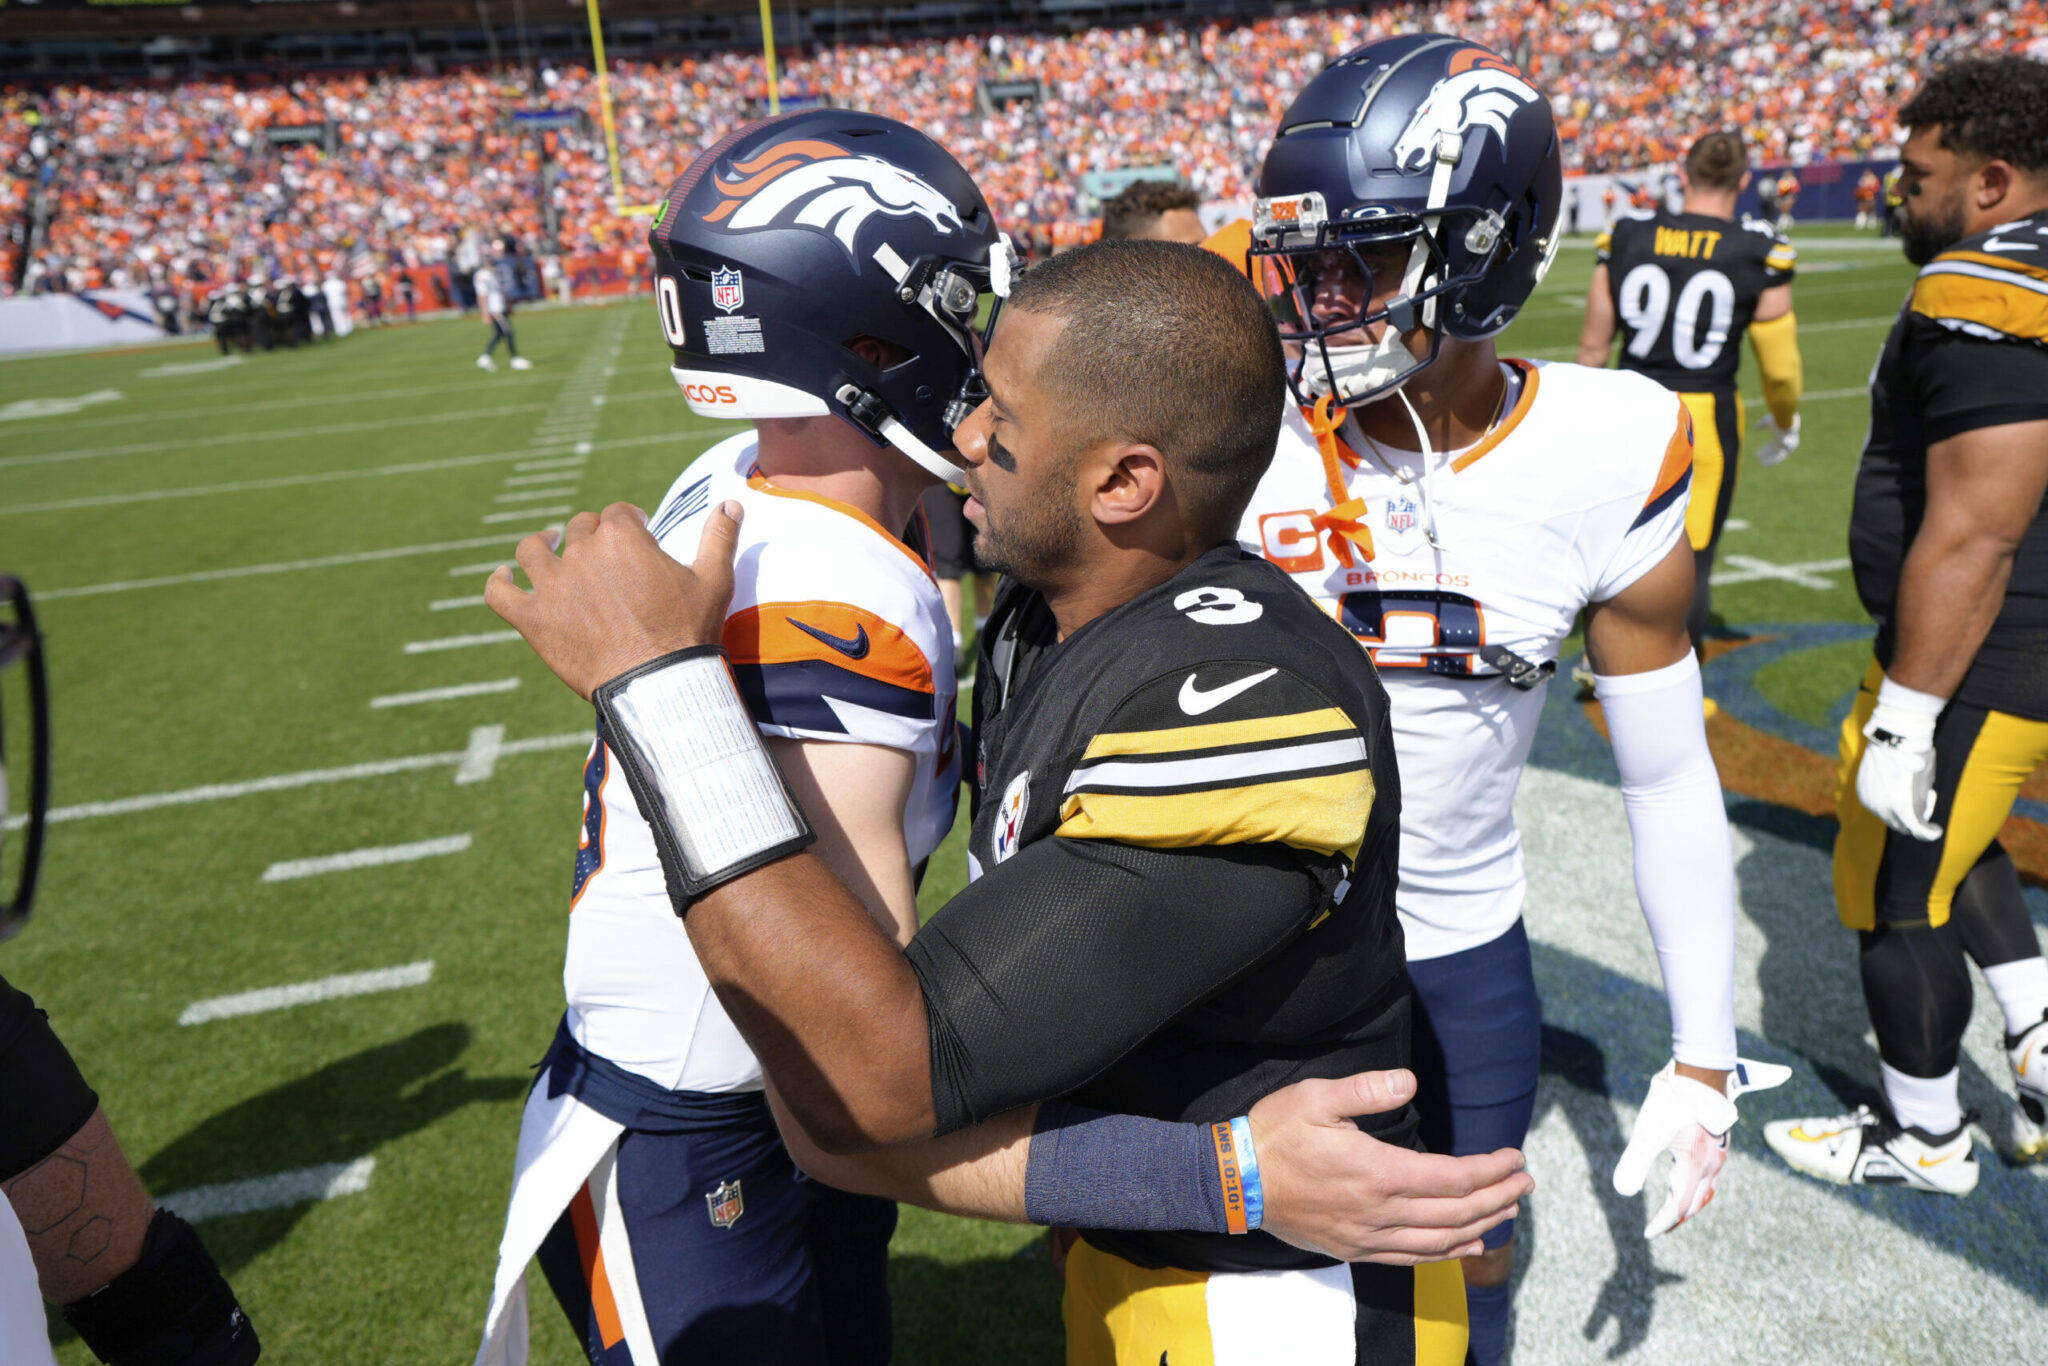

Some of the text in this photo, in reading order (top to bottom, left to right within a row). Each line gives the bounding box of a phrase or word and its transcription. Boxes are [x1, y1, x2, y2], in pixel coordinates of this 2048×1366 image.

[1654, 225, 1722, 260] WATT
[654, 275, 685, 347] 0
[716, 286, 739, 305] NFL
[1619, 263, 1735, 370] 90
[680, 384, 737, 404] NCOS
[1263, 514, 1318, 558] C
[1391, 514, 1414, 529] NFL
[1346, 570, 1470, 587] BRONCOS
[1174, 586, 1264, 625] 3
[1216, 1122, 1233, 1154] ANS
[714, 1199, 740, 1221] NFL
